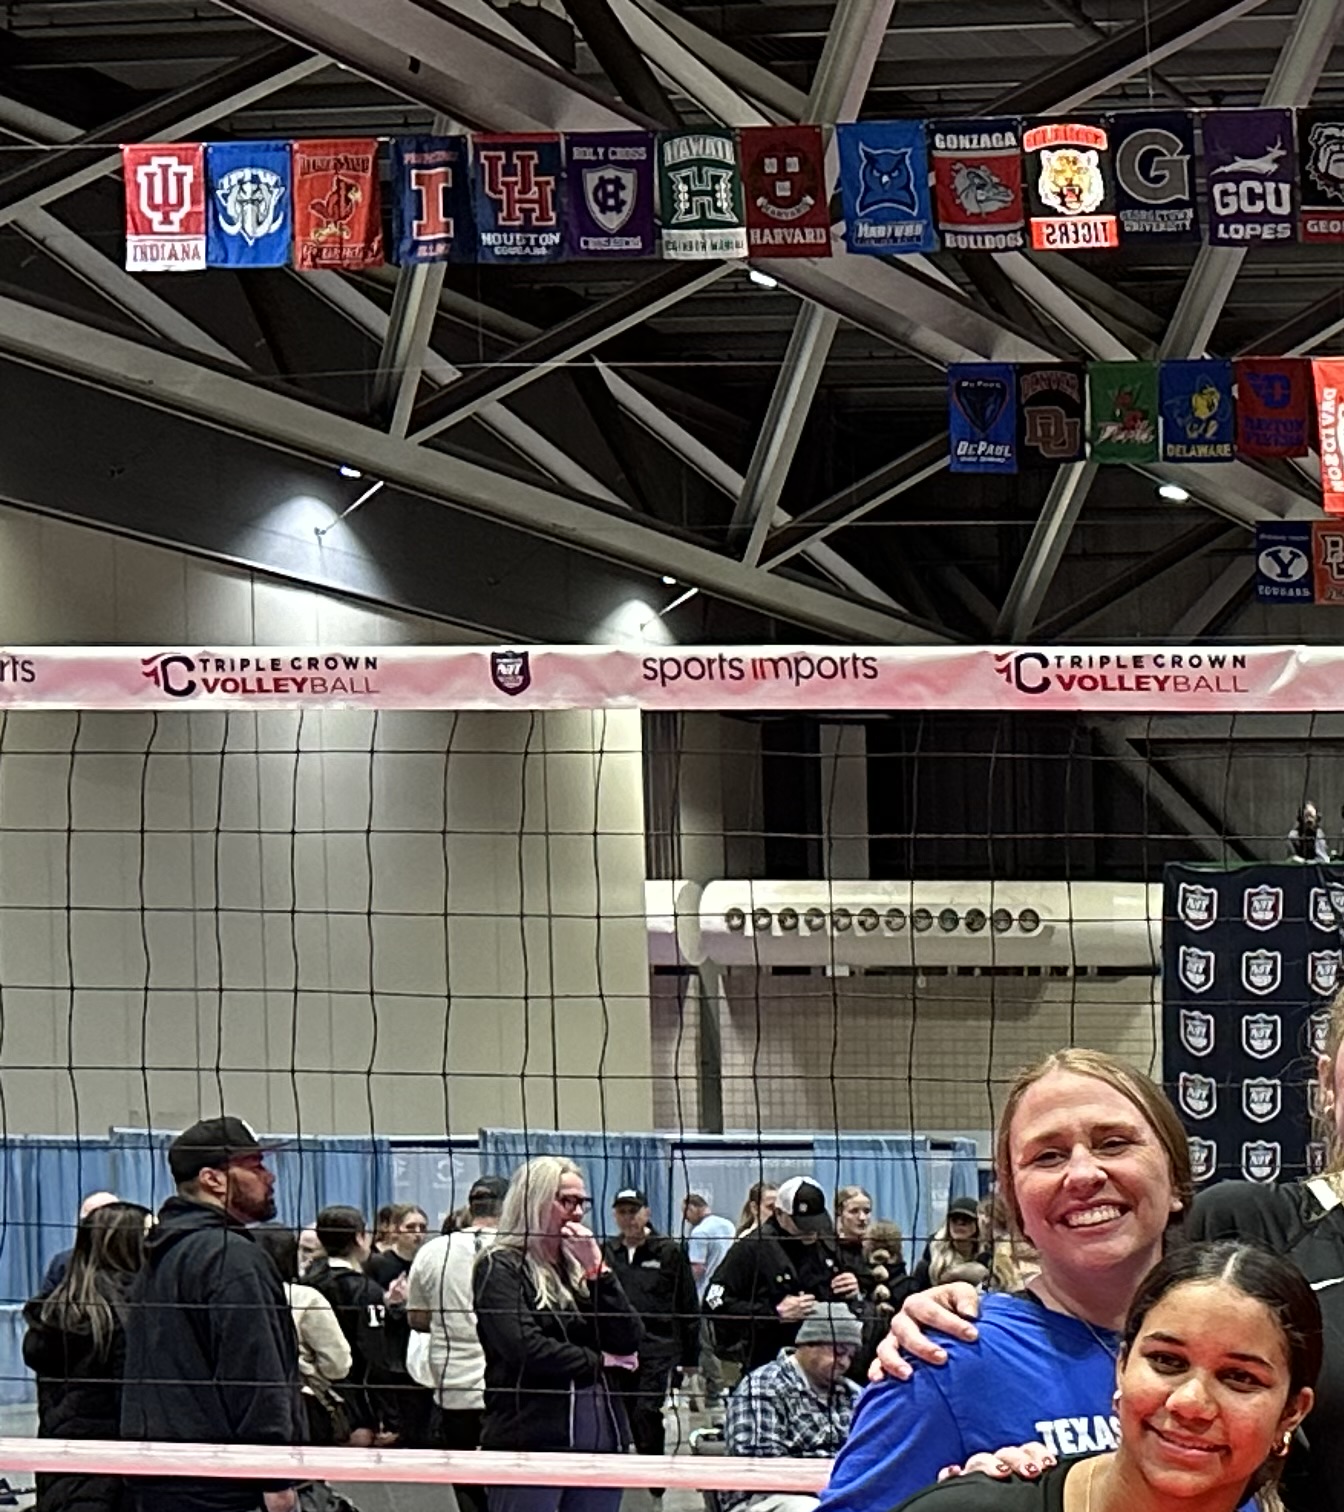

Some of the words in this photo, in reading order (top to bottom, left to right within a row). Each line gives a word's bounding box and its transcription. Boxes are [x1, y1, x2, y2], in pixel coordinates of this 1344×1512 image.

[934, 132, 1017, 149] GONZAGA
[573, 147, 603, 160] HOLY
[608, 147, 647, 160] CROSS
[1116, 128, 1191, 205] G
[1213, 180, 1291, 215] GCU
[481, 233, 560, 246] HOUSTON
[751, 228, 826, 244] HARVARD
[1217, 222, 1291, 240] LOPES
[945, 232, 1023, 249] BULLDOGS
[132, 243, 201, 262] INDIANA
[1167, 444, 1231, 457] DELAWARE
[1266, 550, 1302, 578] Y
[199, 657, 284, 672] TRIPLE
[290, 656, 379, 672] CROWN
[642, 652, 744, 690] sports
[752, 650, 878, 686] imports
[1054, 655, 1146, 670] TRIPLE
[1153, 654, 1247, 669] CROWN
[200, 676, 381, 695] VOLLEYBALL
[1056, 674, 1249, 692] VOLLEYBALL
